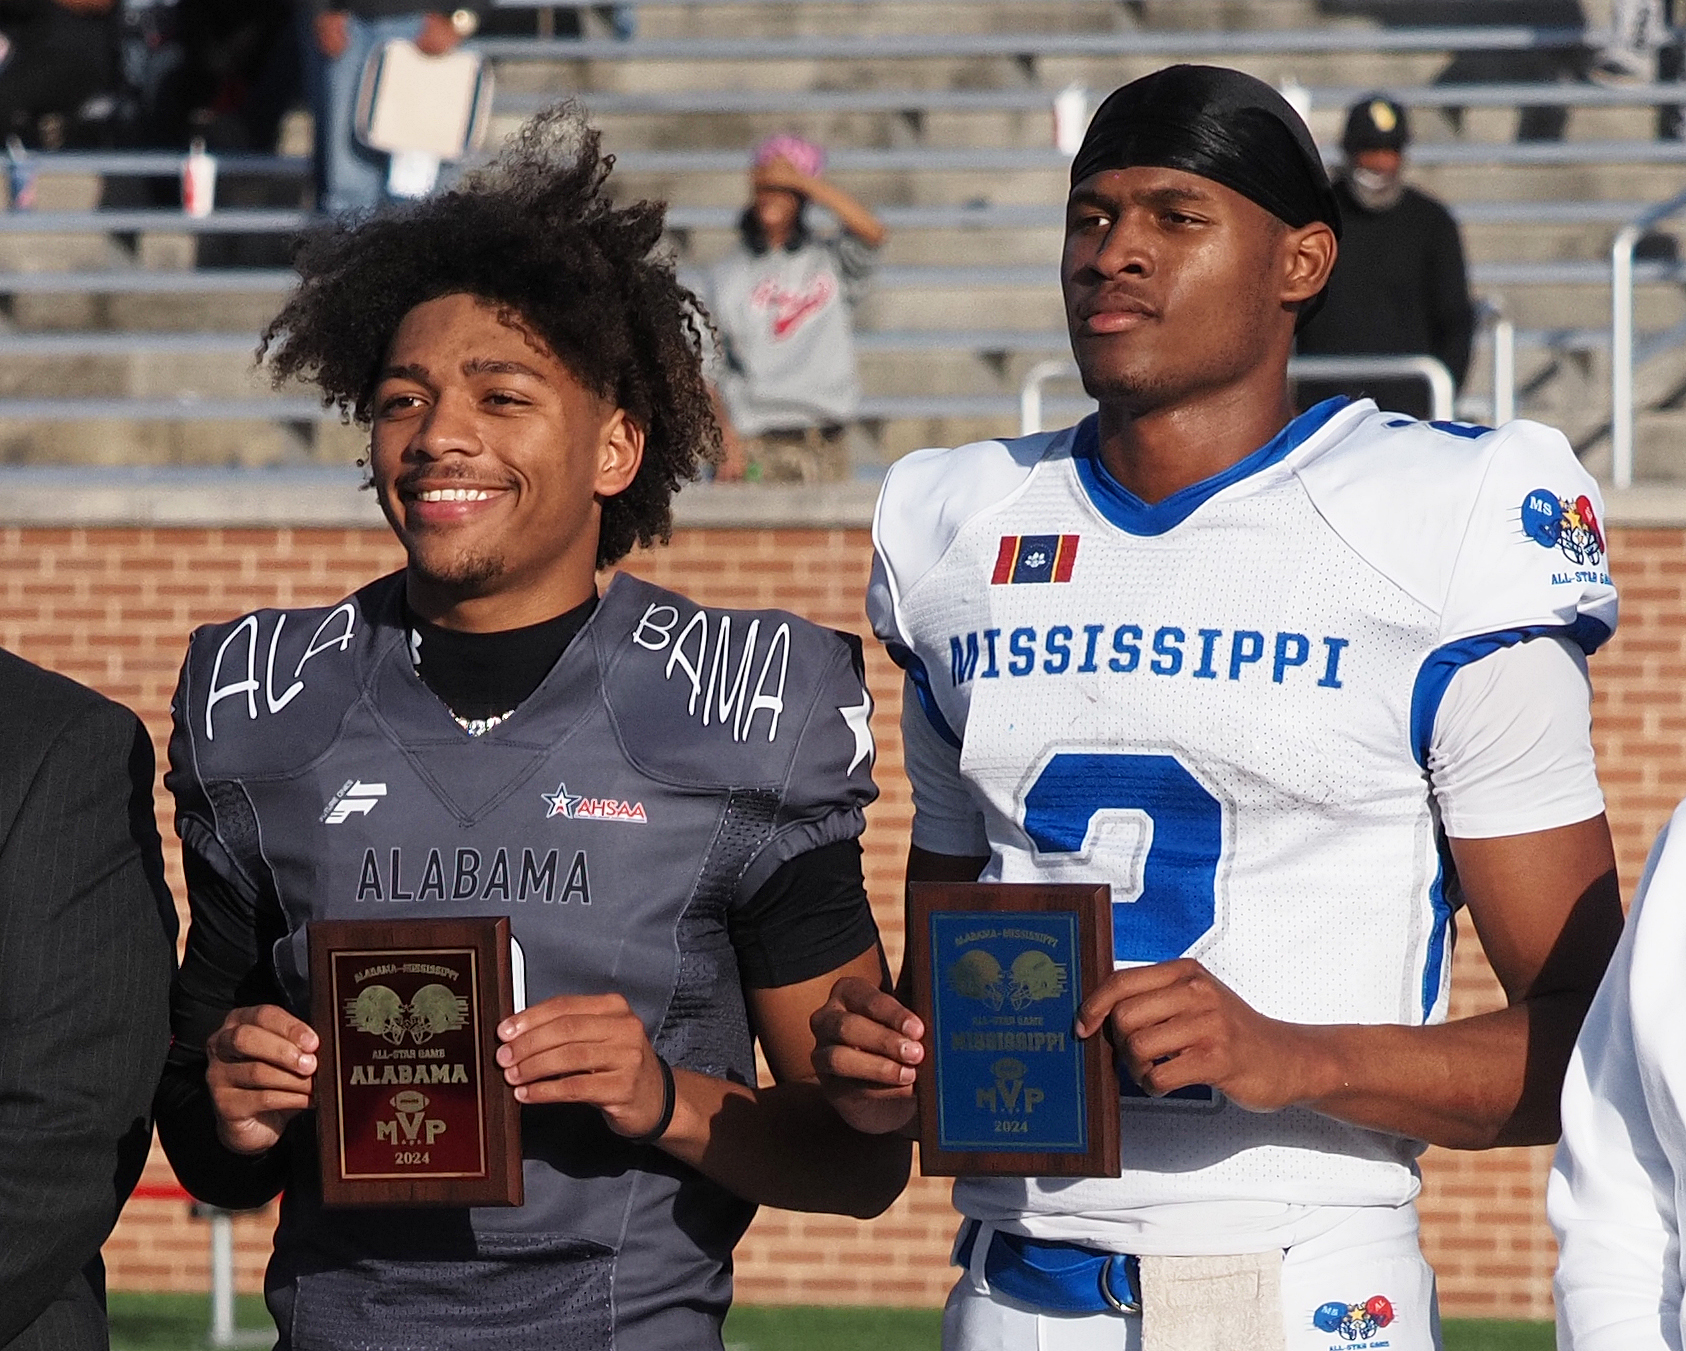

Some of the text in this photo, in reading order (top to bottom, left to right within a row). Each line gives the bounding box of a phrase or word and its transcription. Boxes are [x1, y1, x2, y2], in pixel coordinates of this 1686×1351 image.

[1529, 496, 1552, 516] MS
[949, 623, 1350, 690] MISSISSIPPI
[204, 601, 794, 744] ALA BAMA
[577, 798, 646, 819] AHSAA
[355, 846, 592, 906] ALABAMA
[951, 1031, 1065, 1052] MISSISSIPPI
[350, 1064, 468, 1085] ALABAMA
[976, 1079, 1045, 1114] MVP
[376, 1112, 447, 1146] MVP
[994, 1120, 1028, 1133] 2024
[394, 1151, 430, 1165] 2024
